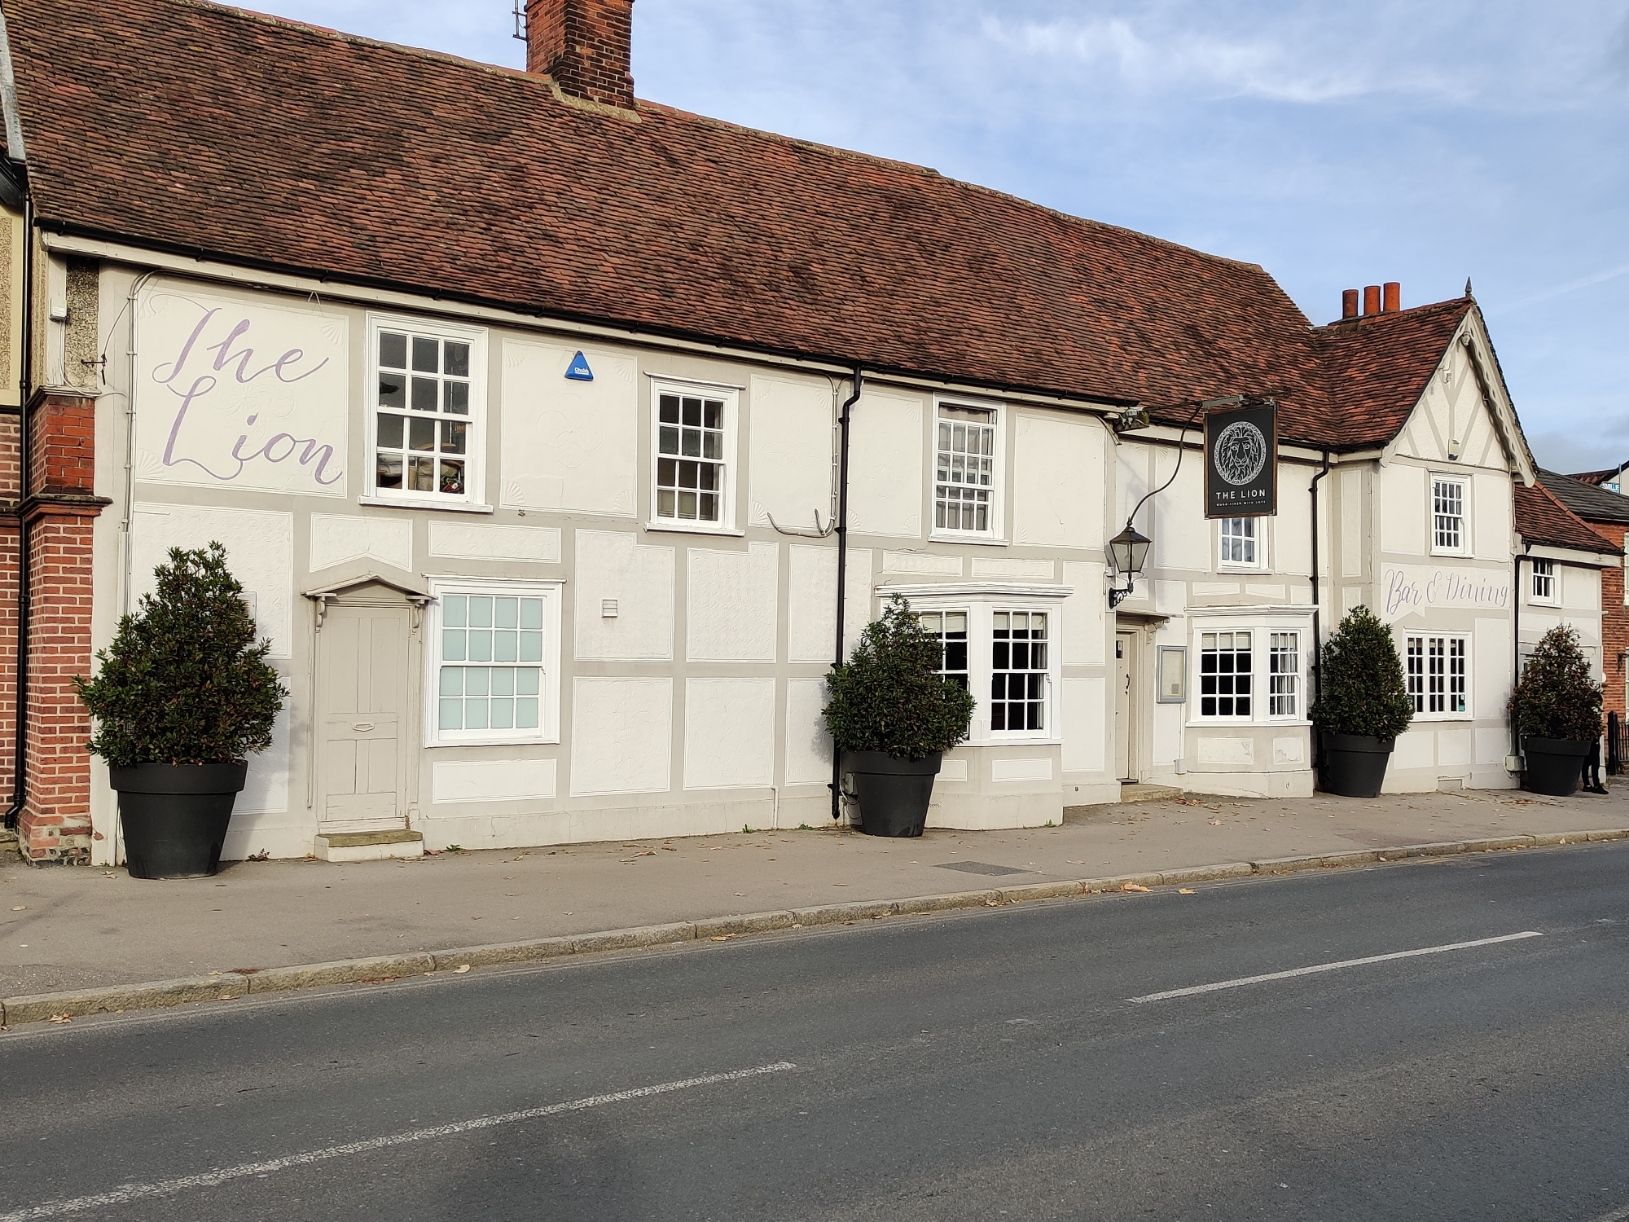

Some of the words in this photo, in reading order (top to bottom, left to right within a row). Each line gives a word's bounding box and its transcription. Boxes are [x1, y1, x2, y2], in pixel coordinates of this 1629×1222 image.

[149, 294, 329, 384] The
[163, 376, 343, 485] Lion
[1215, 490, 1235, 499] THE
[1240, 489, 1266, 498] LION
[1384, 569, 1423, 615] Bar
[1426, 571, 1443, 604] &
[1446, 572, 1508, 607] Dining
